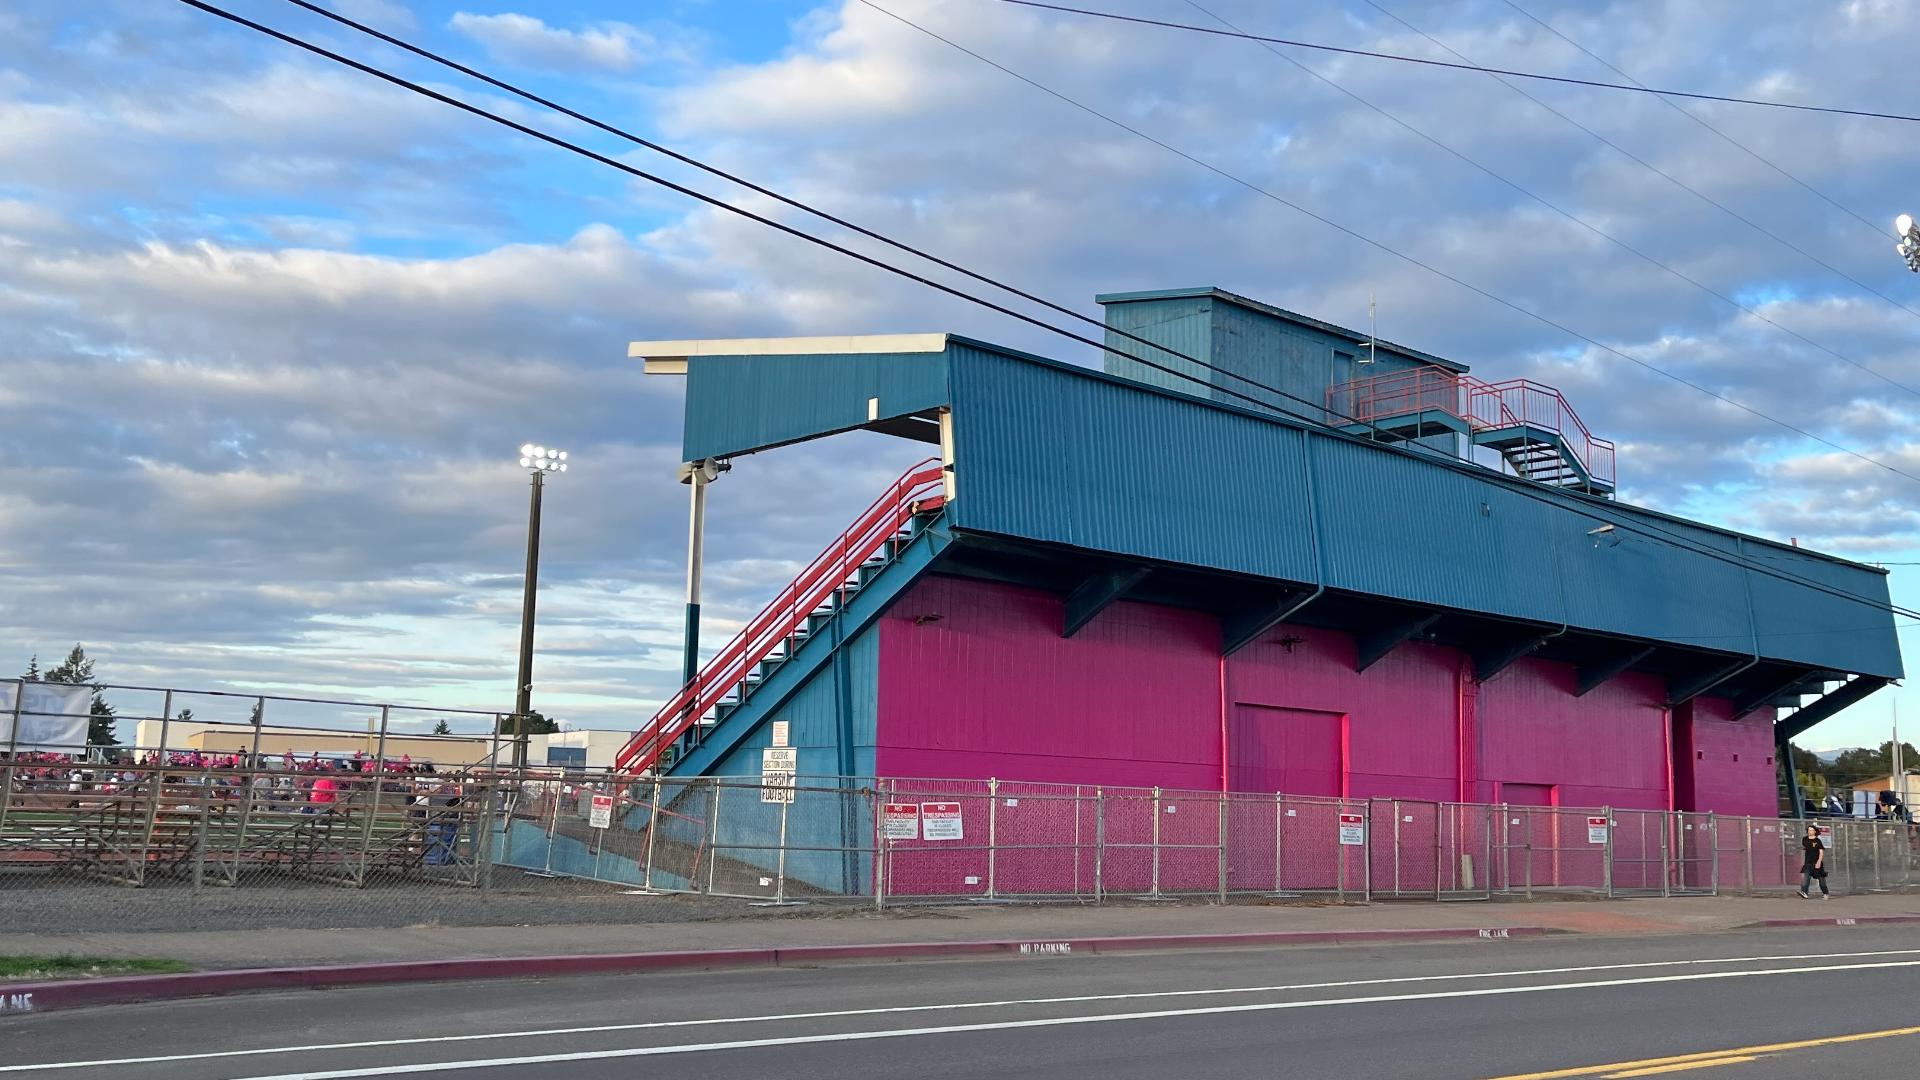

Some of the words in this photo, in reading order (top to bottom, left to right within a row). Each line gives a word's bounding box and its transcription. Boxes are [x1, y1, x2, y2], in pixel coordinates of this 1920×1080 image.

[771, 751, 788, 760] RESERVE
[764, 761, 780, 769] SECTION
[781, 761, 795, 769] DURING
[1020, 943, 1031, 953] NO
[1034, 942, 1071, 953] PARKING
